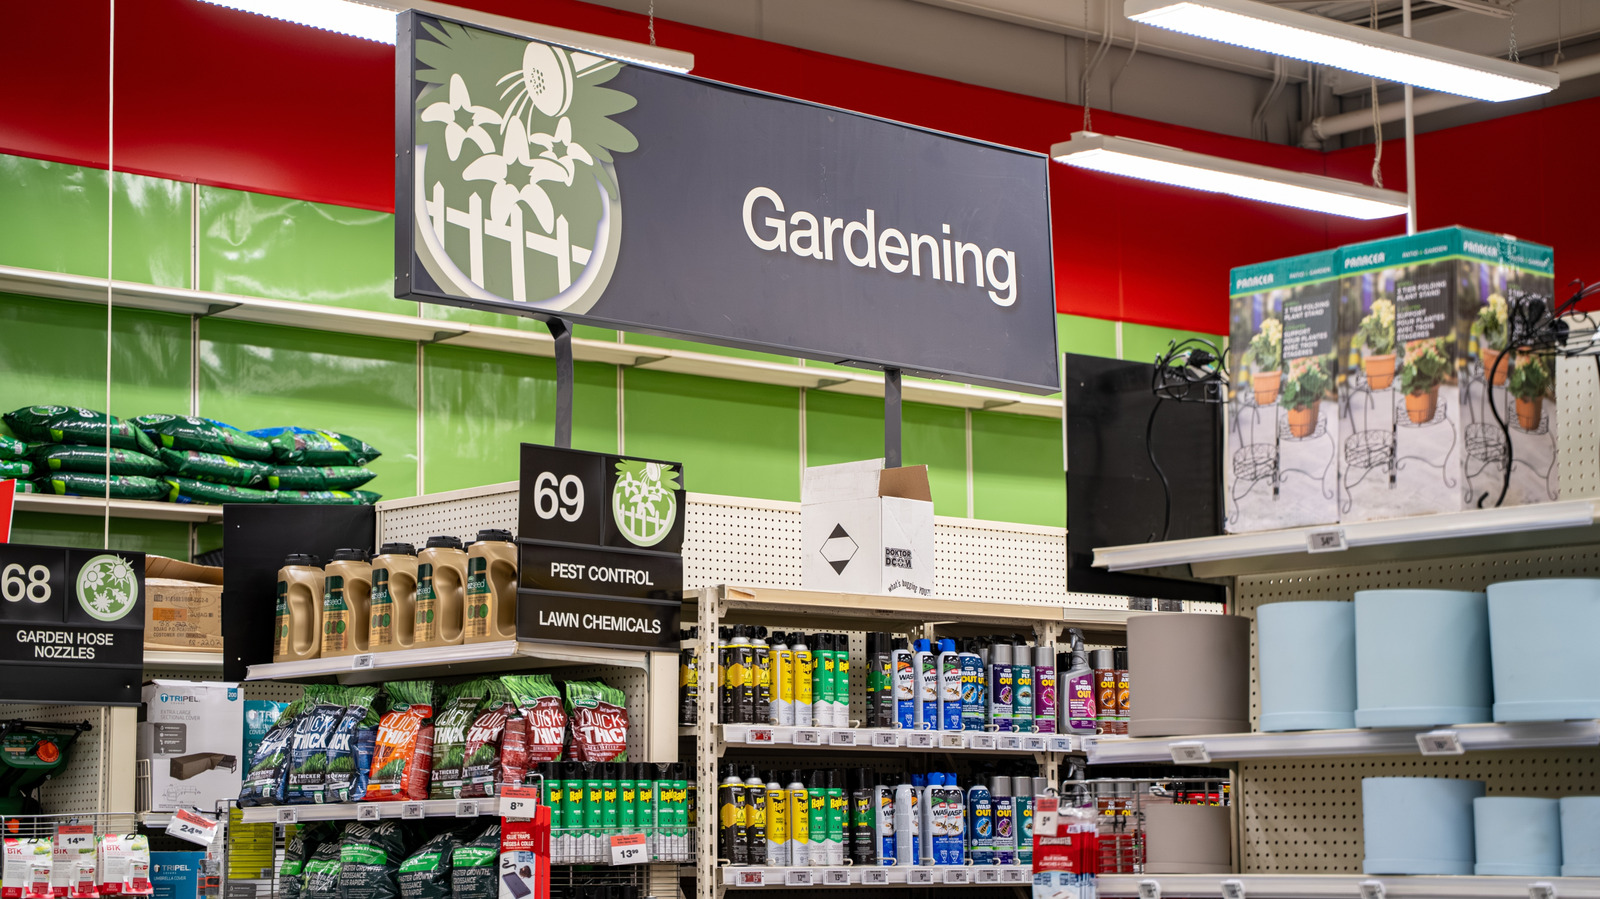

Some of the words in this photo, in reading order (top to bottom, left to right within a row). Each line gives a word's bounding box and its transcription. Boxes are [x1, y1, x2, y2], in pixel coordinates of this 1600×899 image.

[743, 186, 1017, 307] Gardening
[1344, 252, 1385, 269] PANACEA
[1236, 273, 1274, 289] PANACEA
[1418, 280, 1446, 291] FOLDING
[1396, 293, 1417, 302] PLANT
[1419, 289, 1441, 299] STAND
[533, 471, 585, 524] 69
[885, 548, 912, 558] DOKTOR
[550, 561, 586, 581] PEST
[588, 564, 654, 587] CONTROL
[1, 563, 52, 604] 68
[539, 609, 580, 630] LAWN
[582, 613, 661, 636] CHEMICALS
[16, 629, 74, 645] GARDEN
[76, 632, 114, 646] HOSE
[34, 646, 96, 661] NOZZLES
[169, 695, 199, 703] TRIPEL
[1077, 690, 1091, 698] OUT
[292, 734, 328, 750] THICK
[510, 801, 524, 811] 879
[811, 797, 825, 809] Raid
[933, 809, 948, 817] WAS
[180, 824, 203, 835] 2499
[67, 837, 85, 845] 1499
[7, 847, 23, 855] BTK
[107, 844, 121, 852] BTK
[620, 848, 639, 859] 1399
